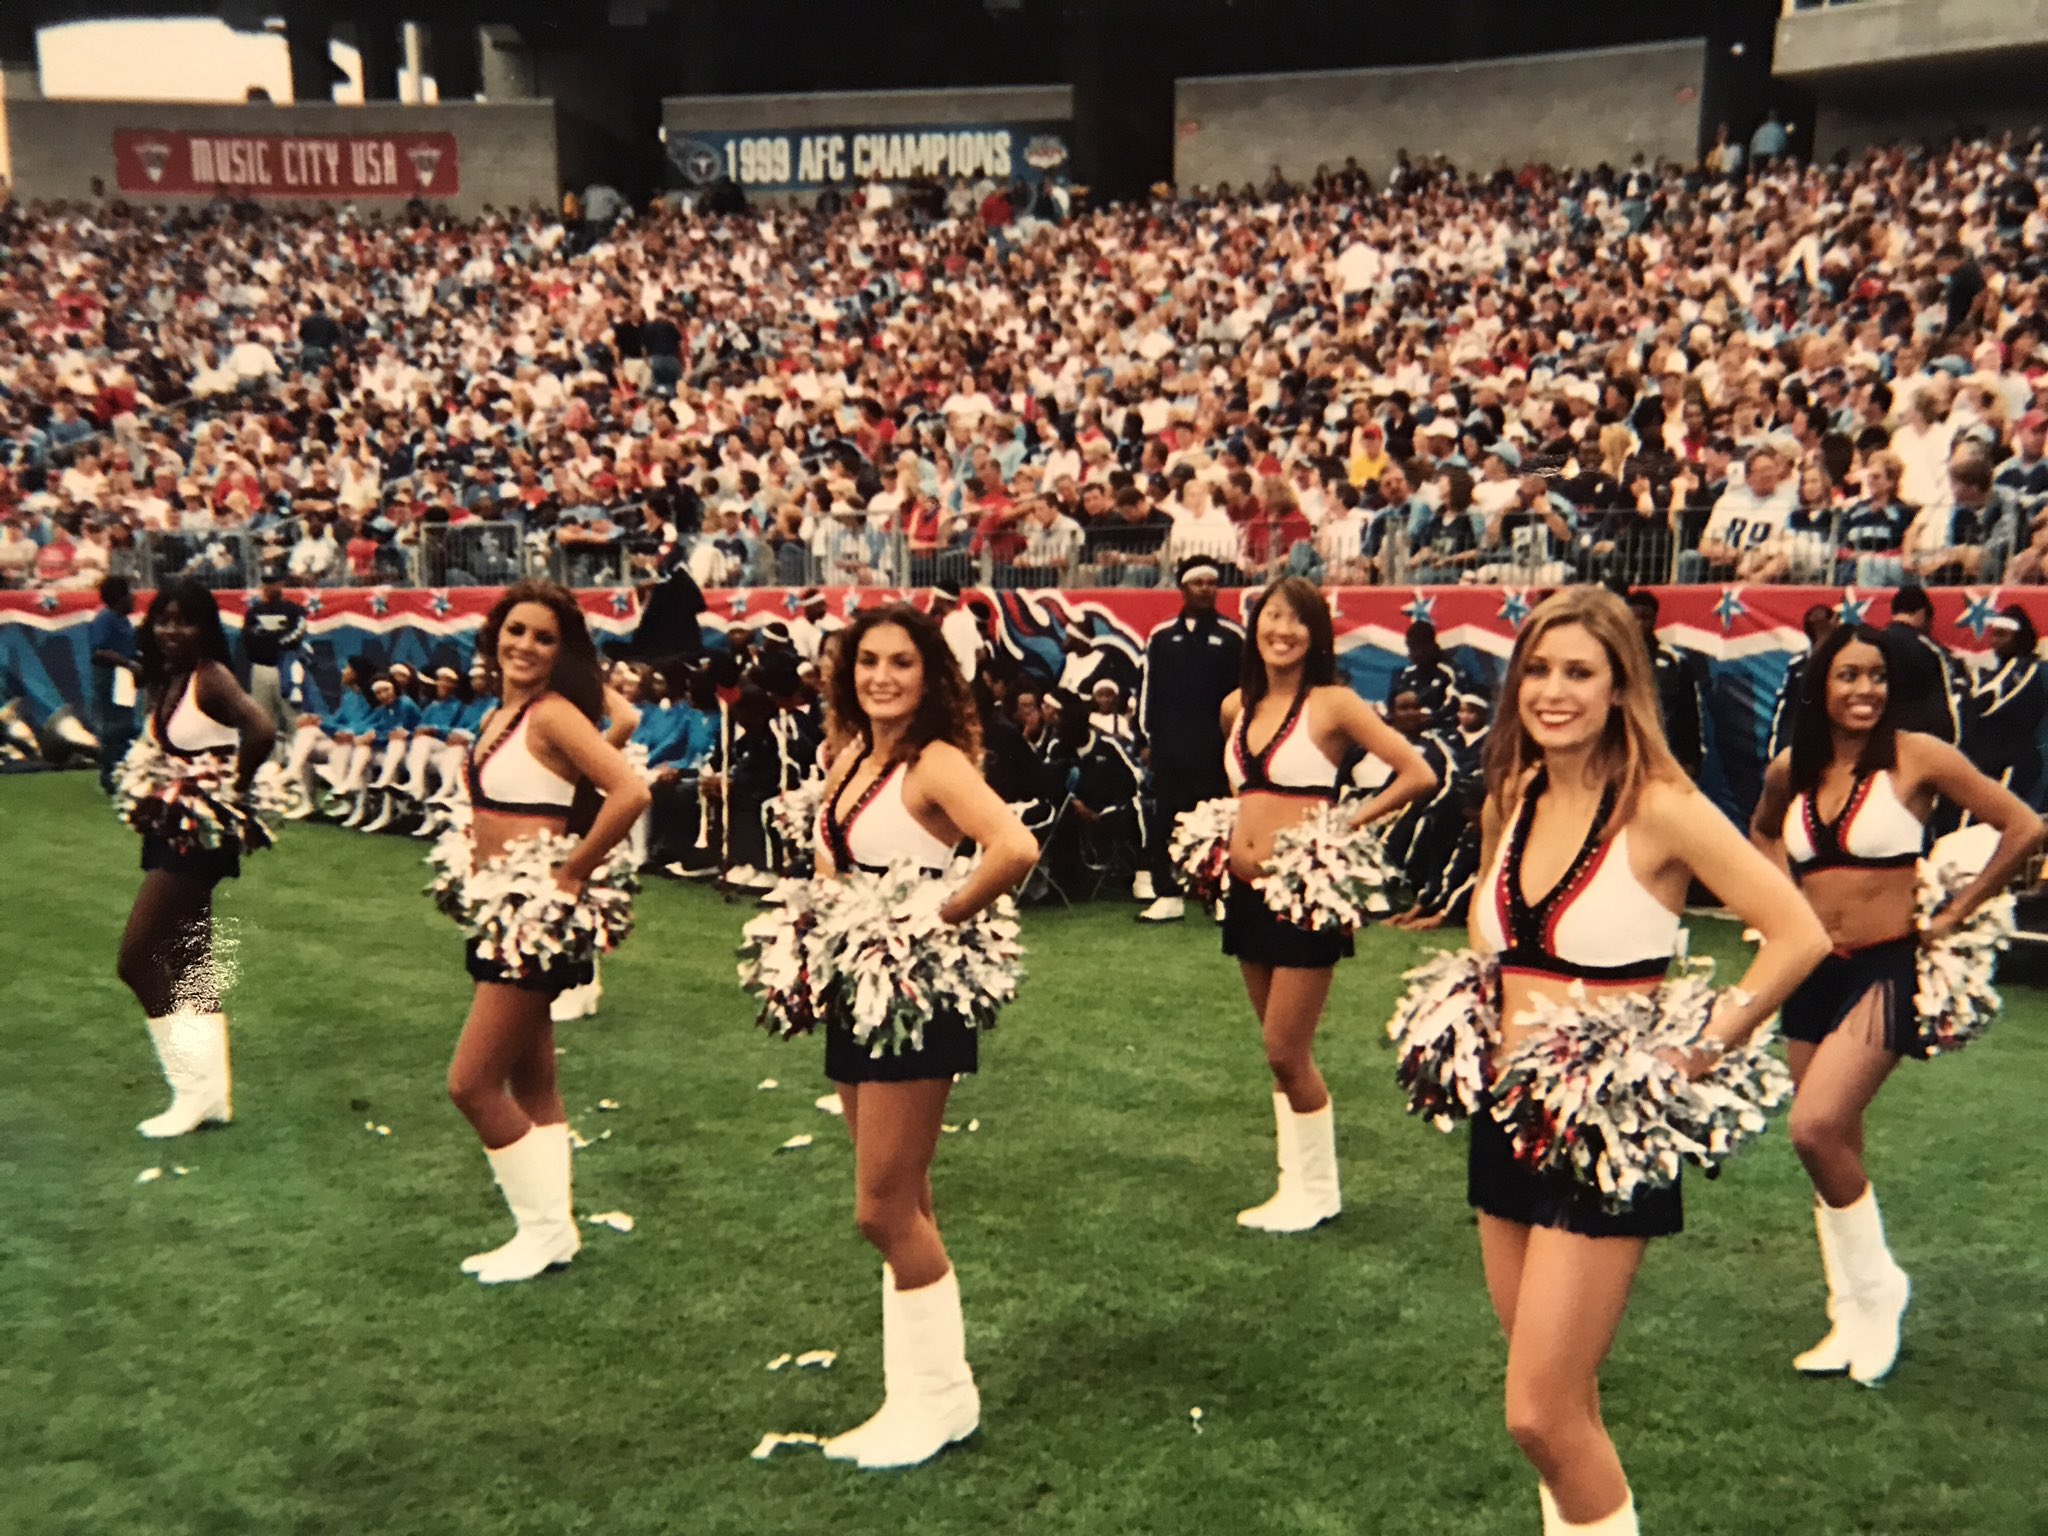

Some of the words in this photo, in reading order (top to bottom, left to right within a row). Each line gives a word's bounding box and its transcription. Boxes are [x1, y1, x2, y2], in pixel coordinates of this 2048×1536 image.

[190, 138, 272, 185] MUSIC
[282, 140, 339, 185] CITY
[350, 141, 398, 186] USA
[725, 137, 790, 184] 1999
[798, 135, 846, 182] AFC
[853, 130, 1012, 178] CHAMPIONS
